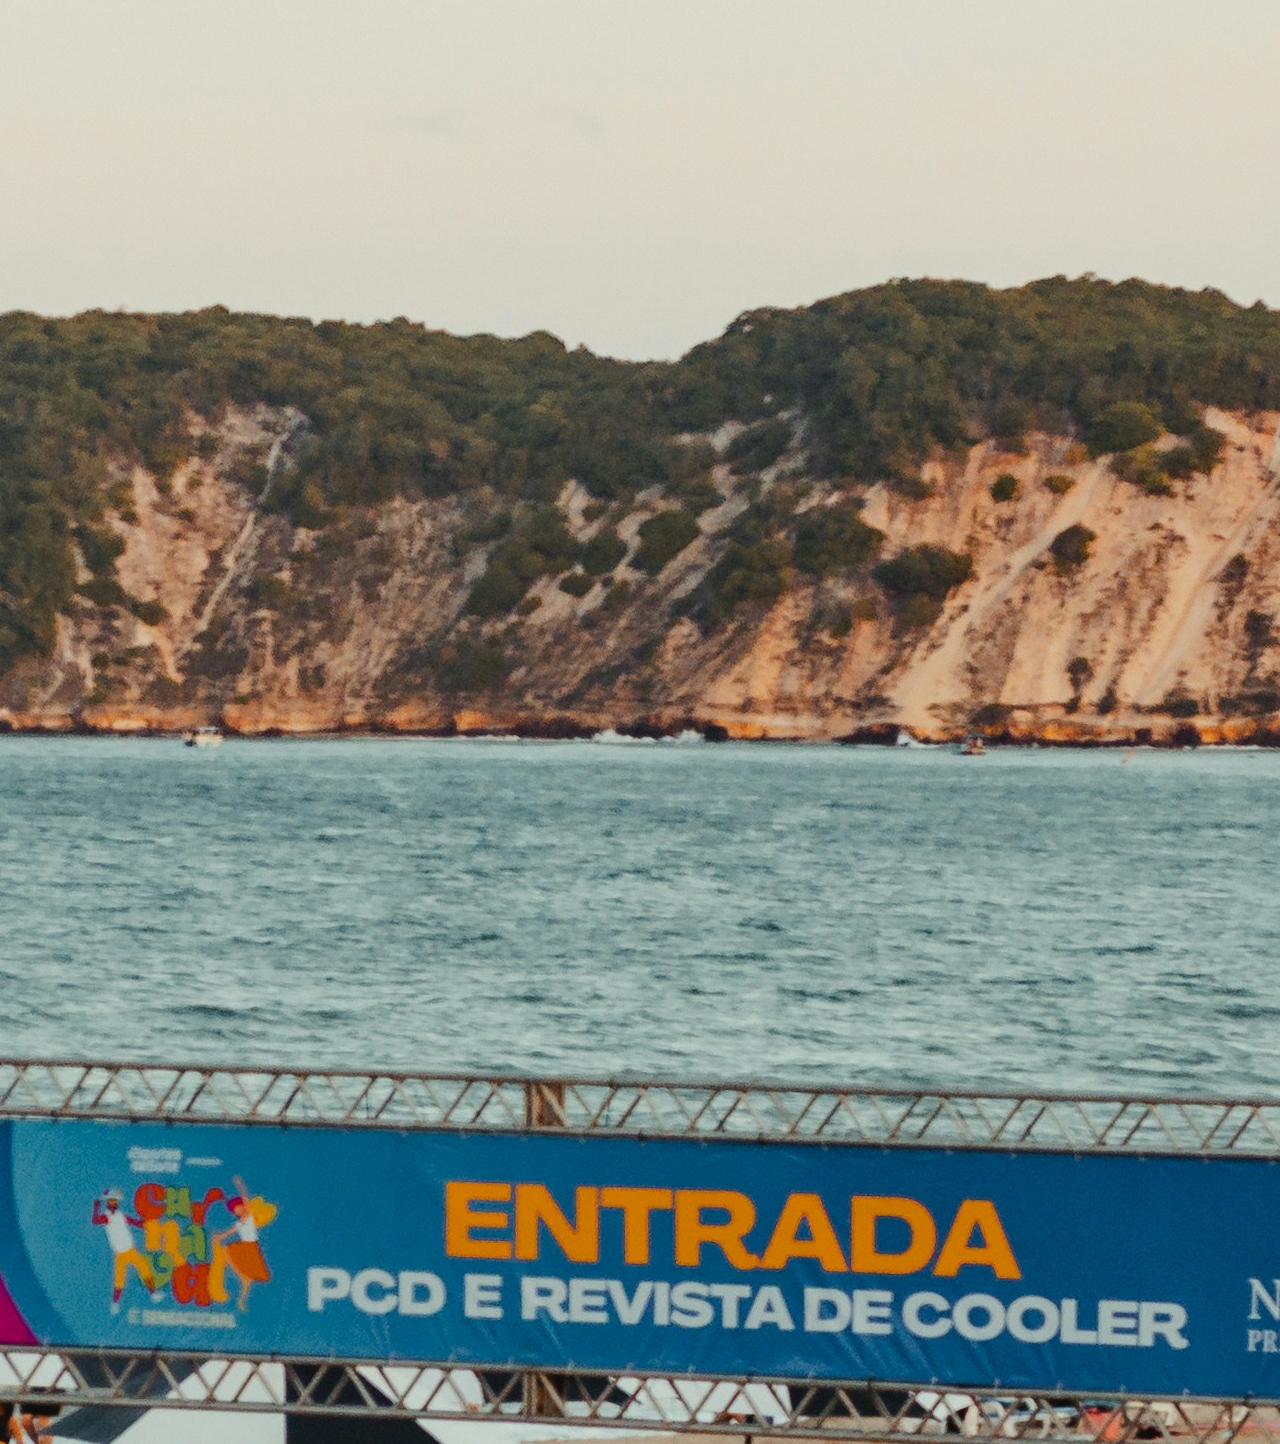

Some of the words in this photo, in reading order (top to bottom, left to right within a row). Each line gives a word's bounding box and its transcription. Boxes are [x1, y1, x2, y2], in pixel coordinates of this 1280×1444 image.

[445, 1180, 1022, 1280] ENTRADA
[306, 1266, 447, 1317] PCD
[463, 1273, 504, 1320] E
[520, 1276, 796, 1330] REVISTA
[803, 1286, 895, 1336] DE
[901, 1290, 1190, 1350] COOLER
